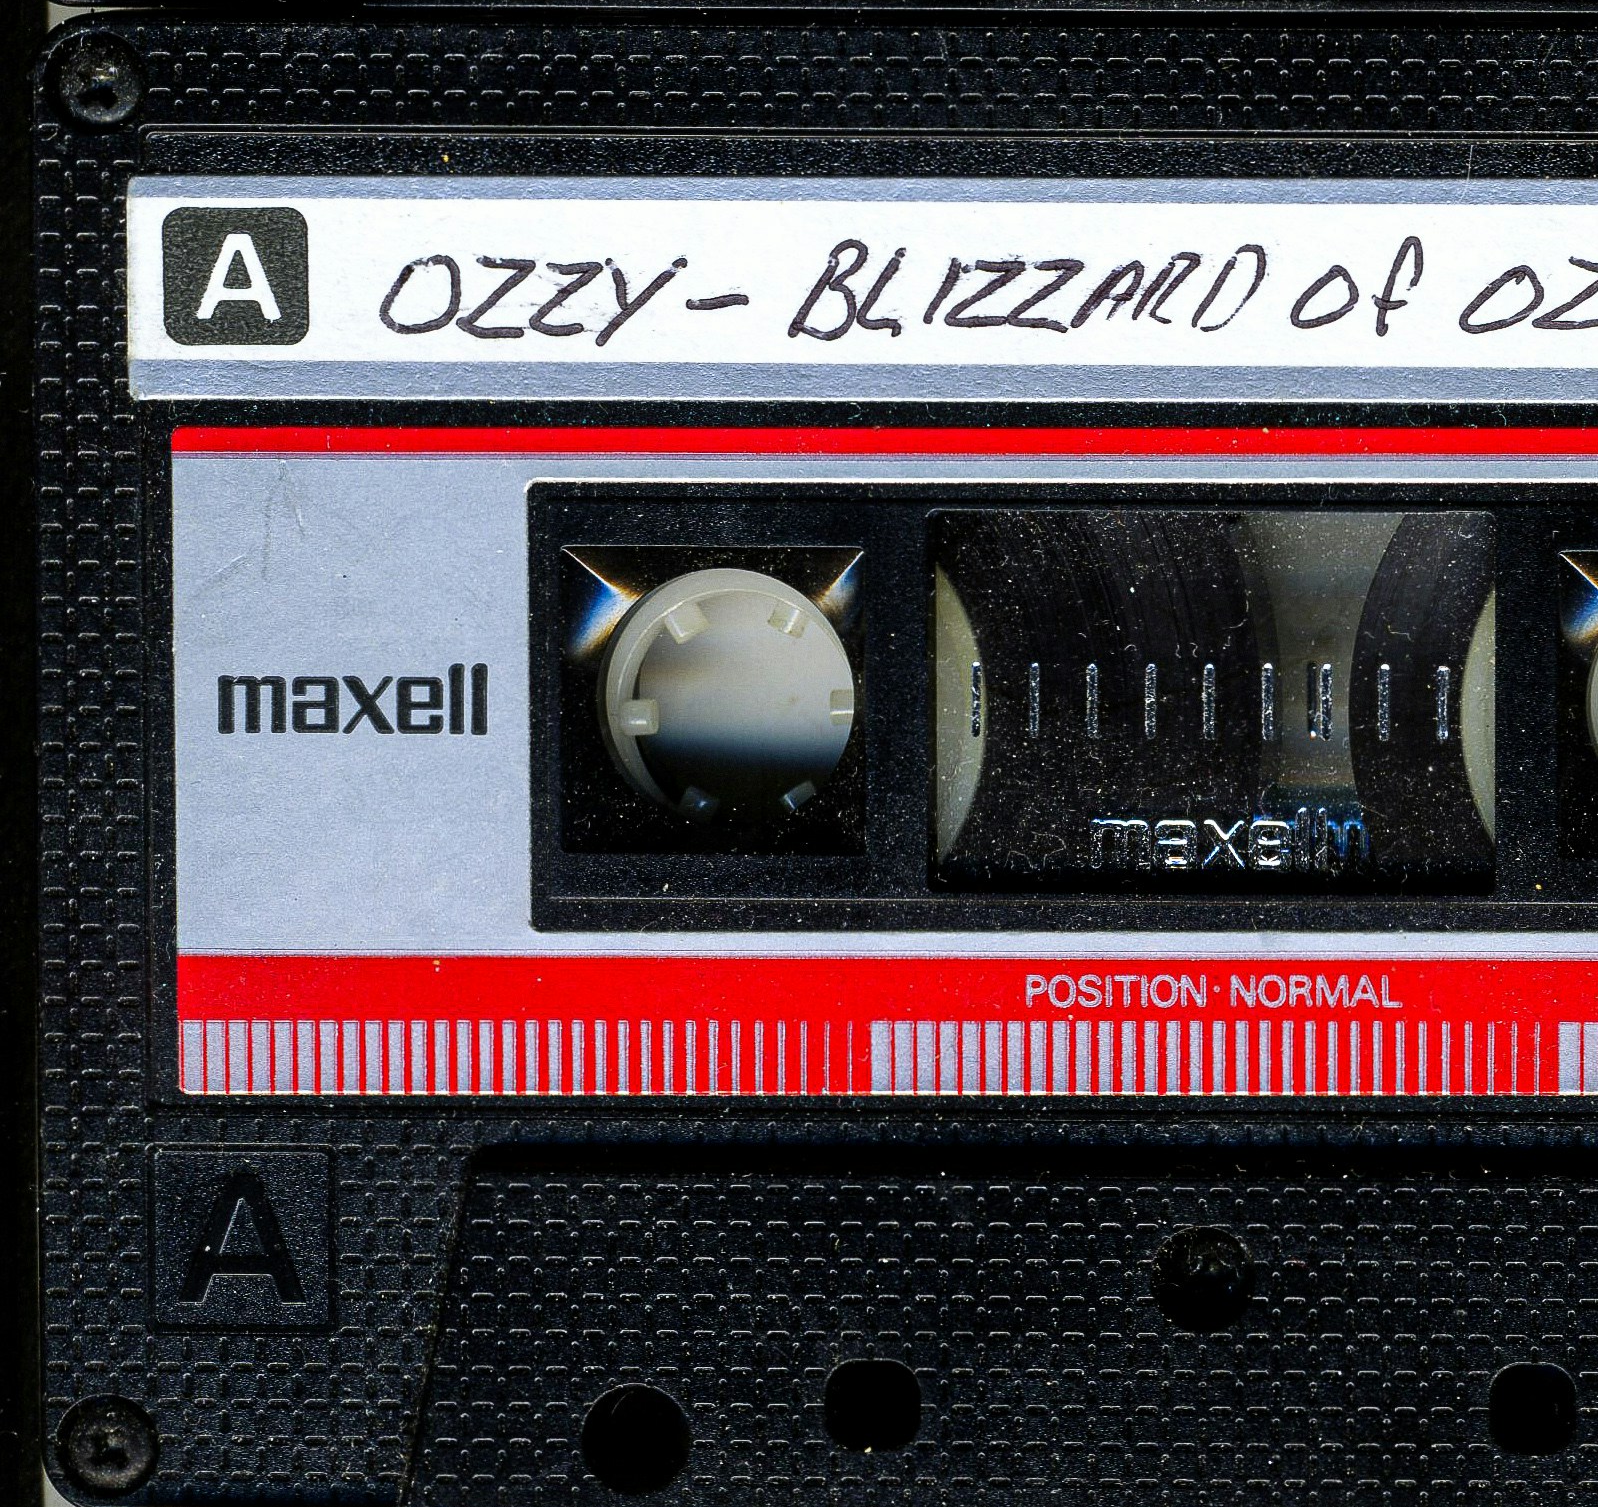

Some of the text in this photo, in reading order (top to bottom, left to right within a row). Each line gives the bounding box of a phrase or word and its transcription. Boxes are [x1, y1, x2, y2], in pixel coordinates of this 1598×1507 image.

[196, 233, 282, 321] A
[787, 239, 1268, 339] BLIZZARD
[217, 663, 488, 735] maxell
[1025, 974, 1403, 1008] POSITION NORMAL
